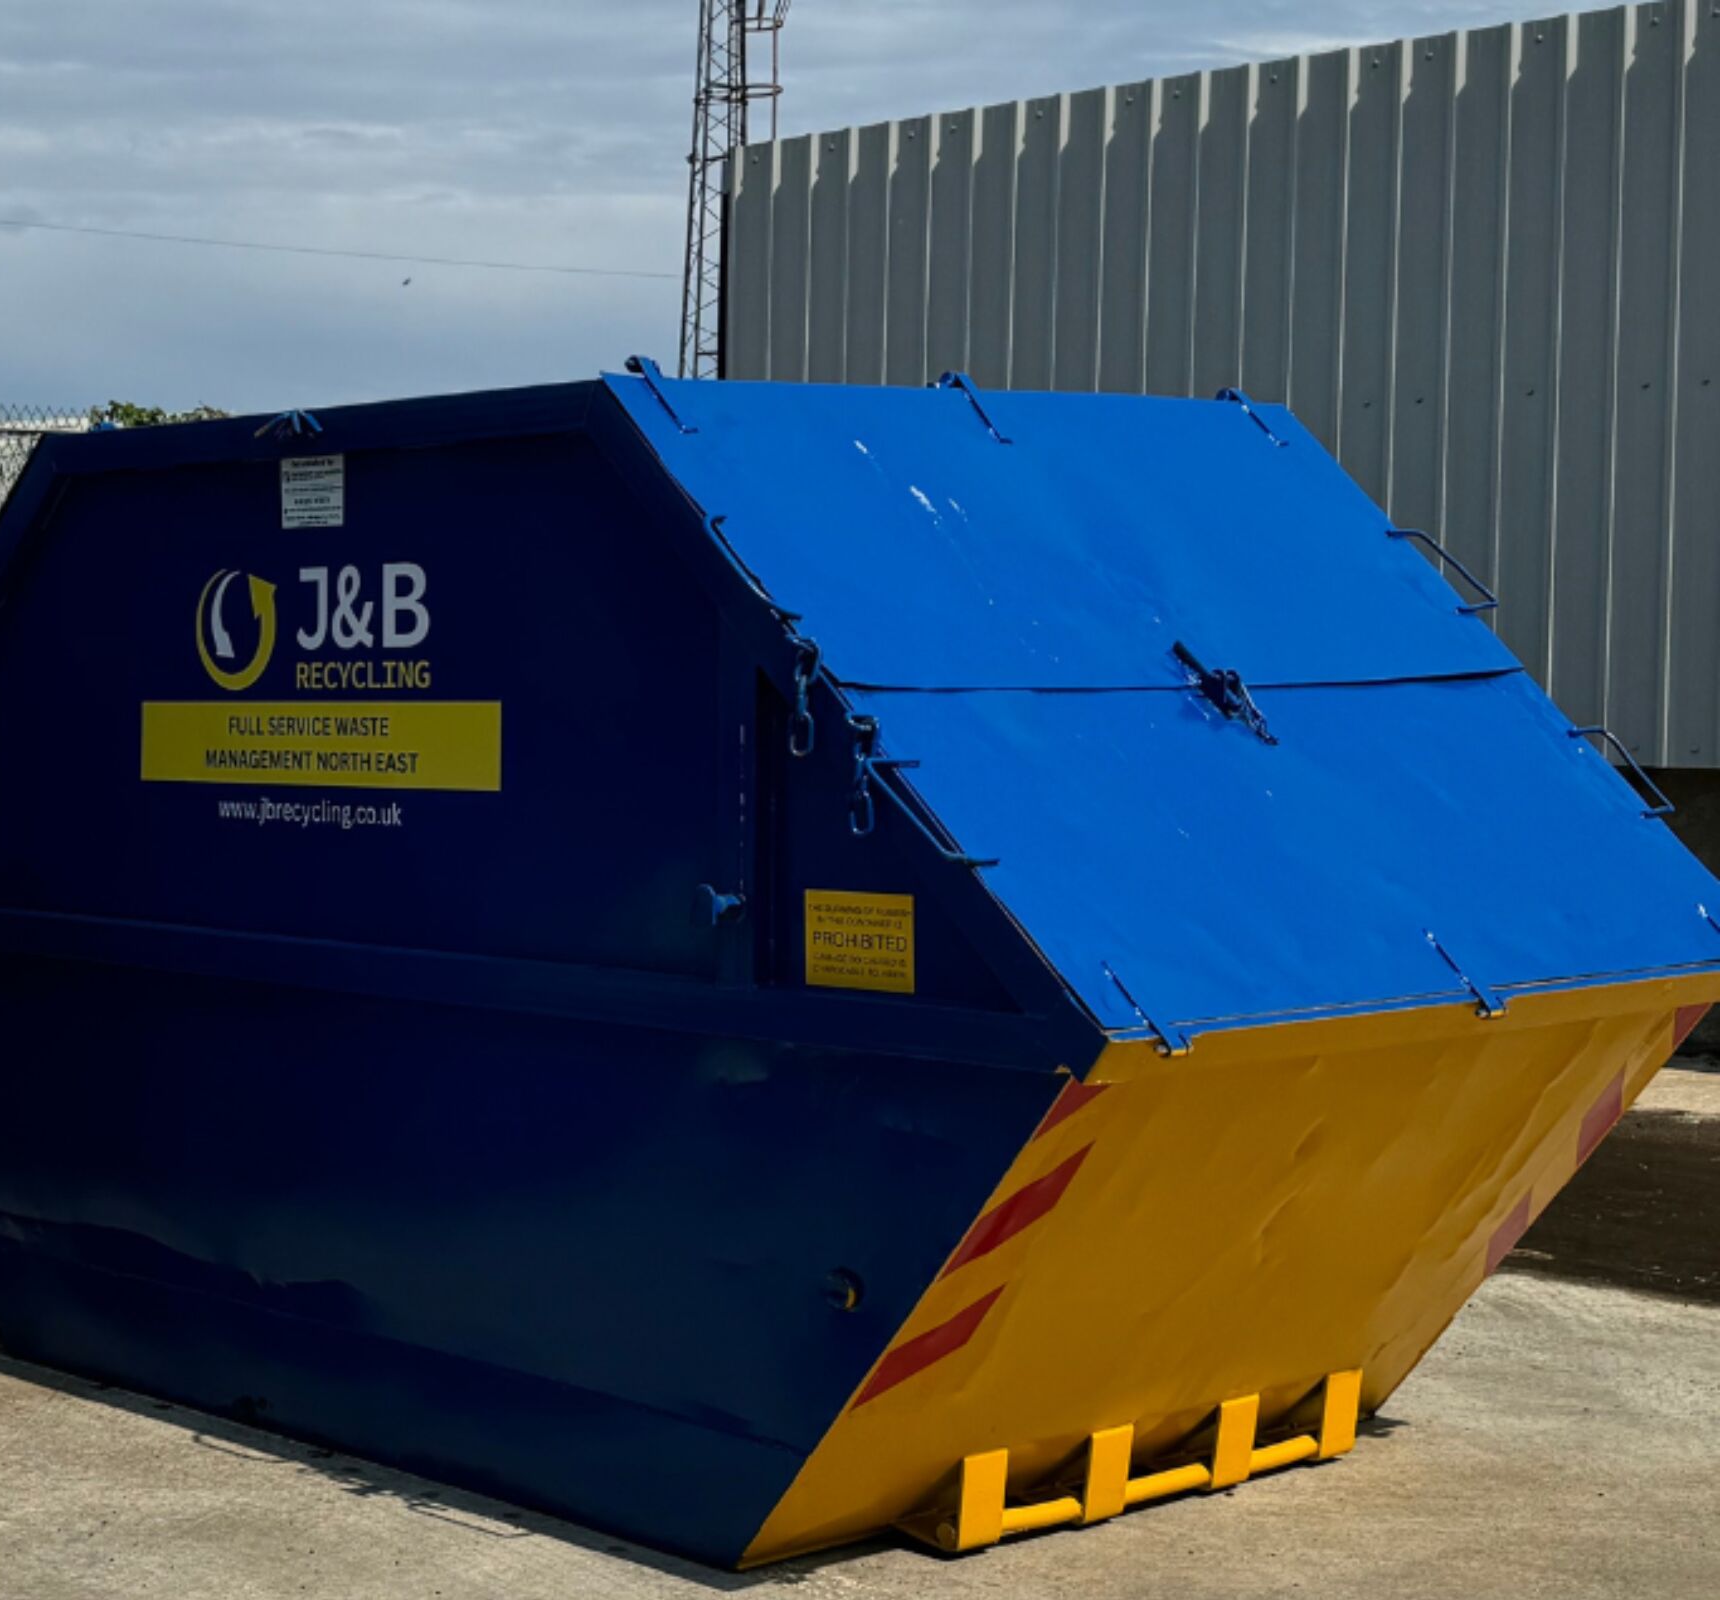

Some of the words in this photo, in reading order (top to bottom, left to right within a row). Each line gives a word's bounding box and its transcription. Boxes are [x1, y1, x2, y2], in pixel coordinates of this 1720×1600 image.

[296, 561, 431, 651] J&B
[296, 660, 431, 689] RECYCLING
[228, 716, 265, 737] FULL
[268, 716, 331, 737] SERVICE
[334, 716, 390, 738] WASTE
[205, 749, 313, 771] MANAGEMENT
[316, 750, 372, 773] NORTH
[375, 751, 419, 774] EAST
[217, 797, 403, 830] www.jbrecycling.co.uk
[812, 930, 907, 953] PROHIBITED
